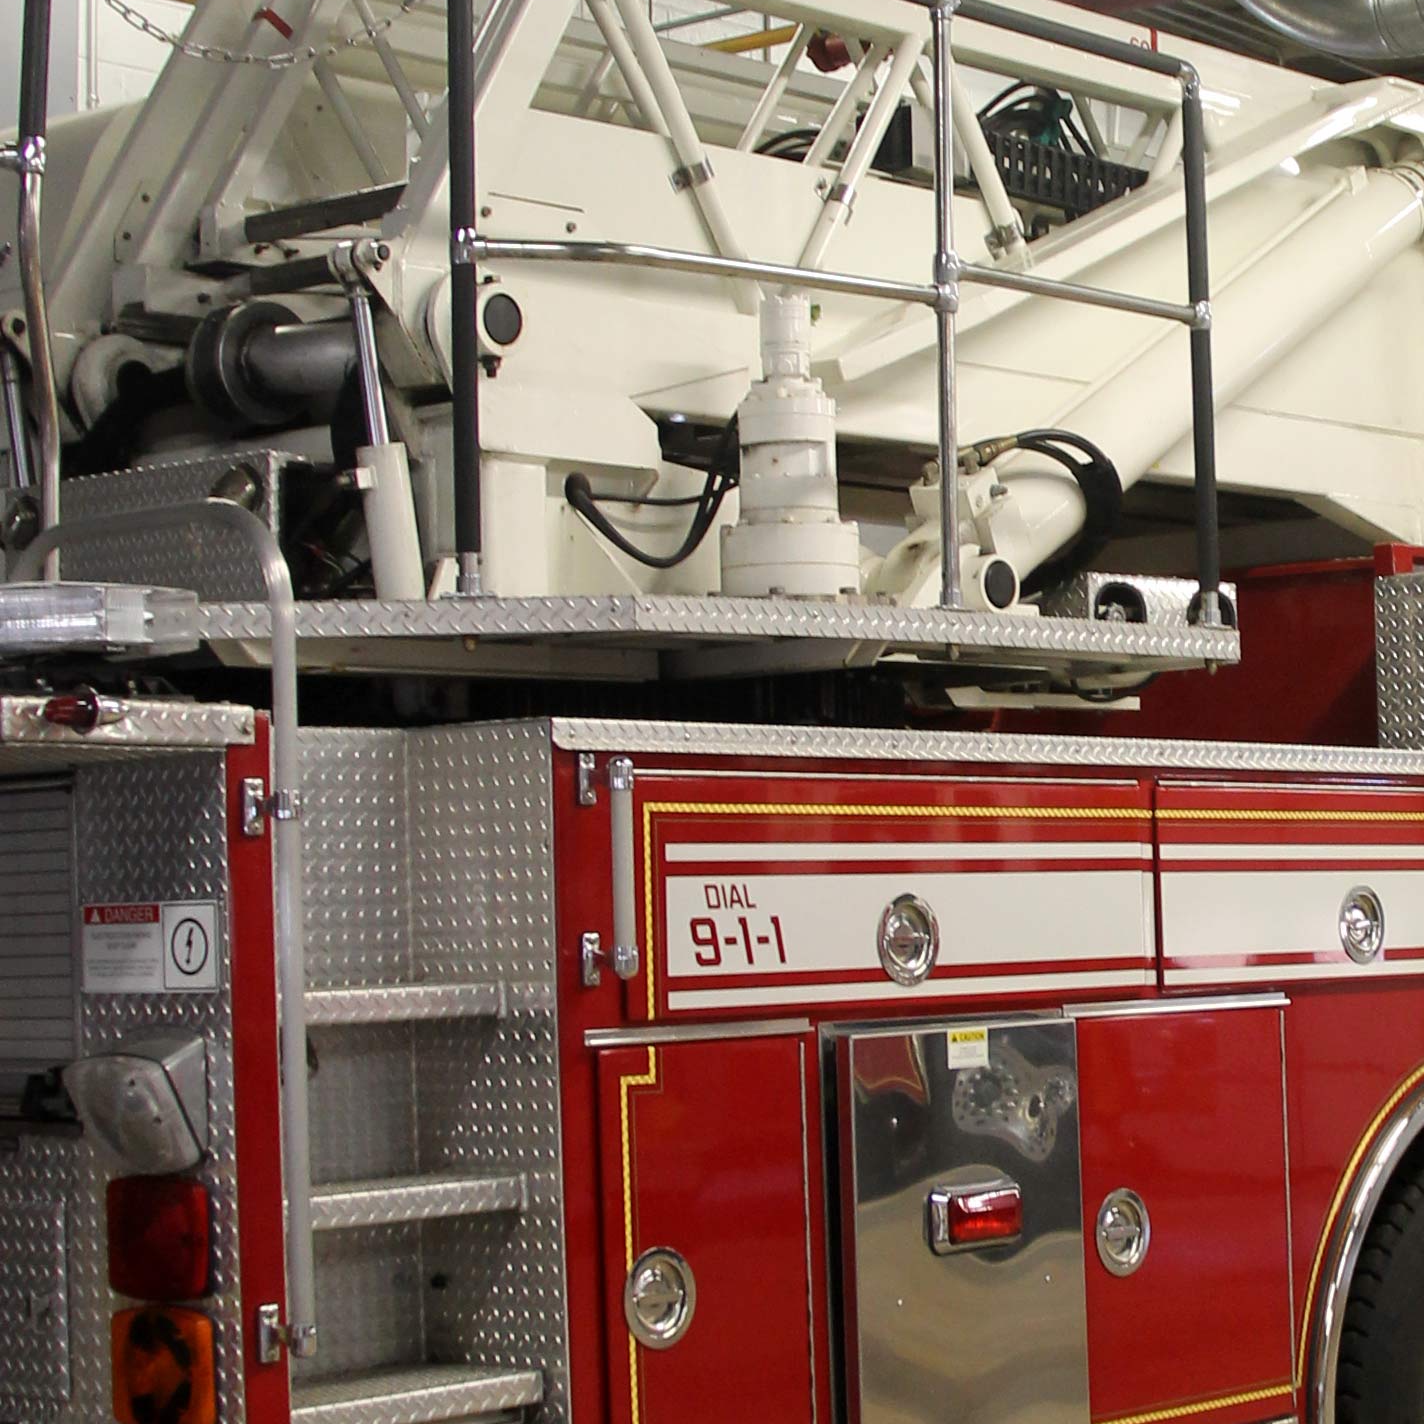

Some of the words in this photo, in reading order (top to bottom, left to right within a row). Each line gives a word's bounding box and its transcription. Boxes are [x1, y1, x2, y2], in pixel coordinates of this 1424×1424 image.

[703, 883, 758, 909] DIAL
[103, 906, 154, 922] DANGER
[690, 915, 787, 967] 9-1-1
